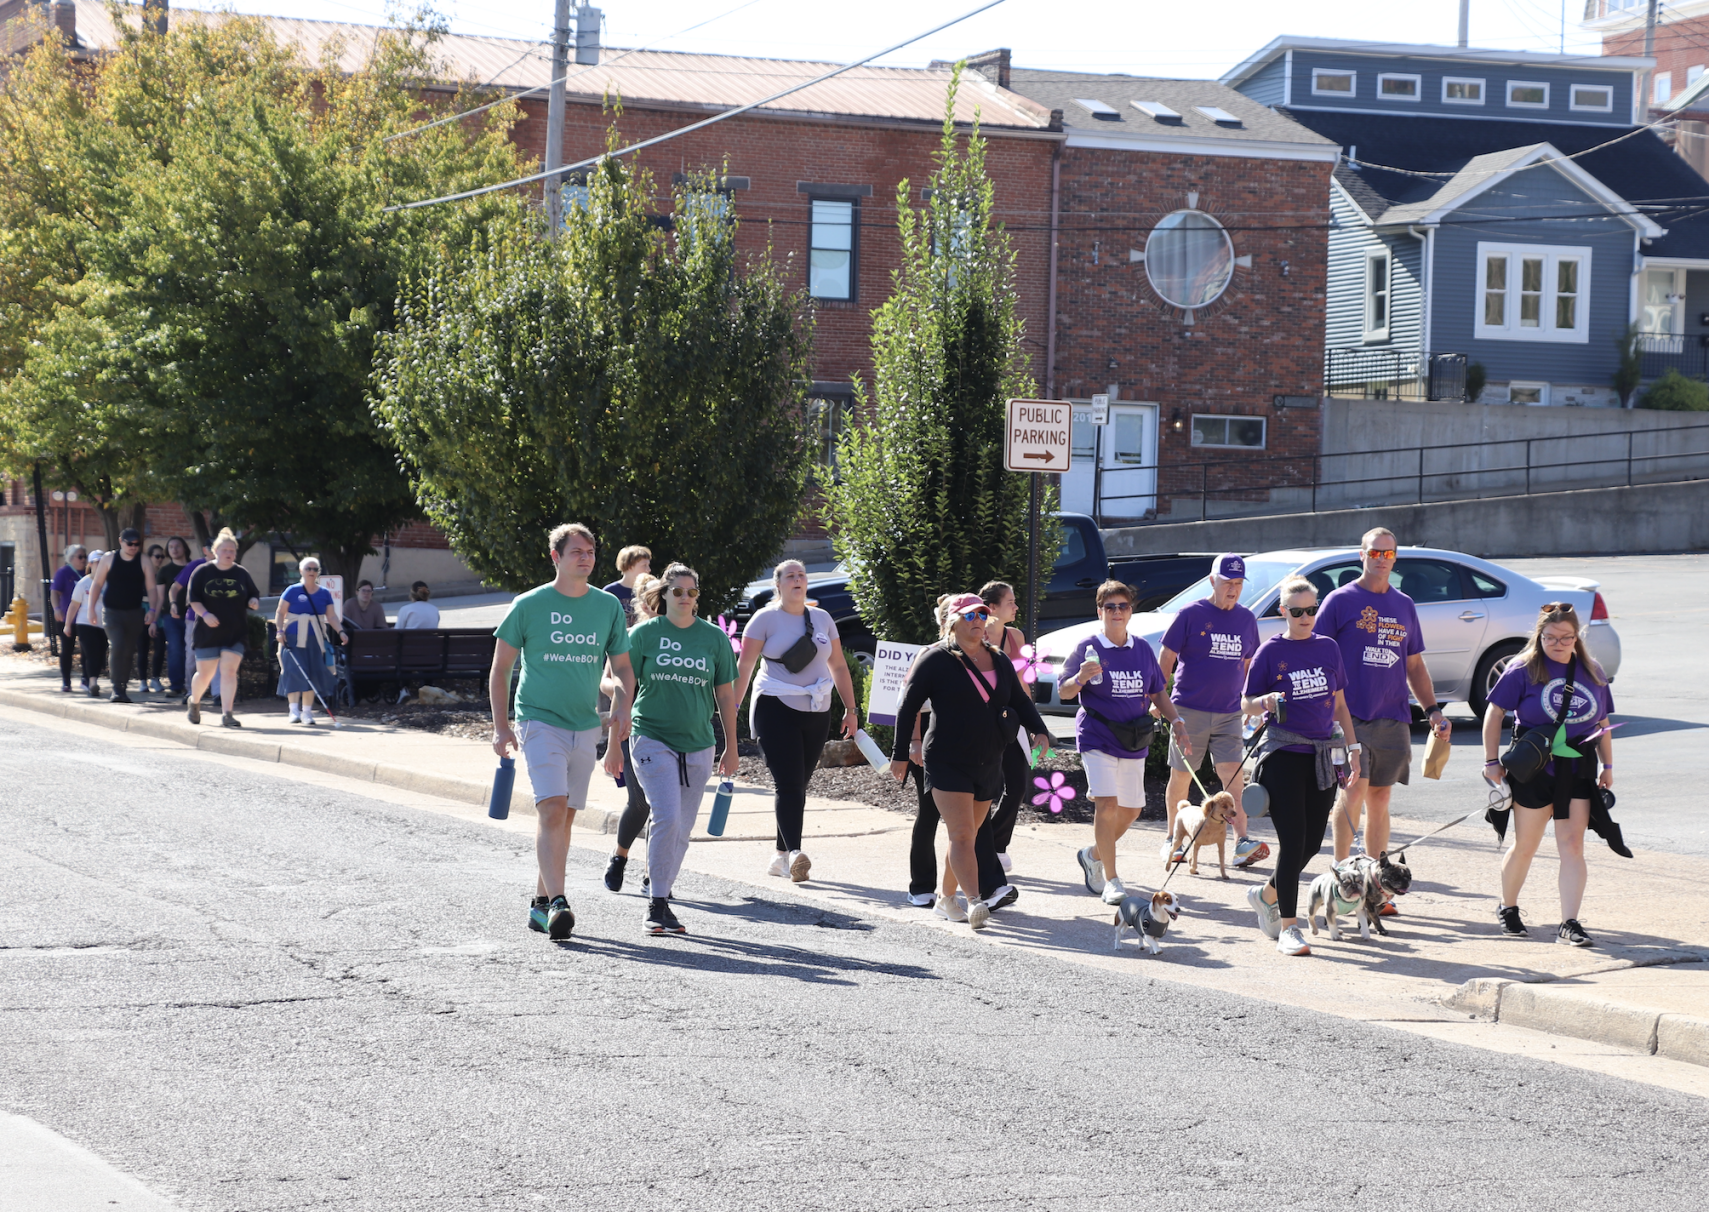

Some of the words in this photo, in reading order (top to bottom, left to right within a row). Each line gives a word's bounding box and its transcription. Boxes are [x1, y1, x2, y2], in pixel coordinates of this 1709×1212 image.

[1019, 408, 1062, 424] PUBLIC
[1014, 428, 1066, 446] PARKING
[326, 580, 335, 589] NO
[550, 612, 572, 624] Do
[1378, 622, 1406, 631] FLOWERS
[550, 630, 600, 646] Good.
[659, 636, 682, 651] Do
[1210, 633, 1242, 643] WALK
[1220, 642, 1242, 652] END
[878, 649, 902, 660] DID
[656, 653, 709, 672] Good.
[1109, 670, 1143, 680] WALK
[1288, 666, 1325, 681] WALK
[1120, 680, 1144, 688] END
[1302, 676, 1327, 689] END
